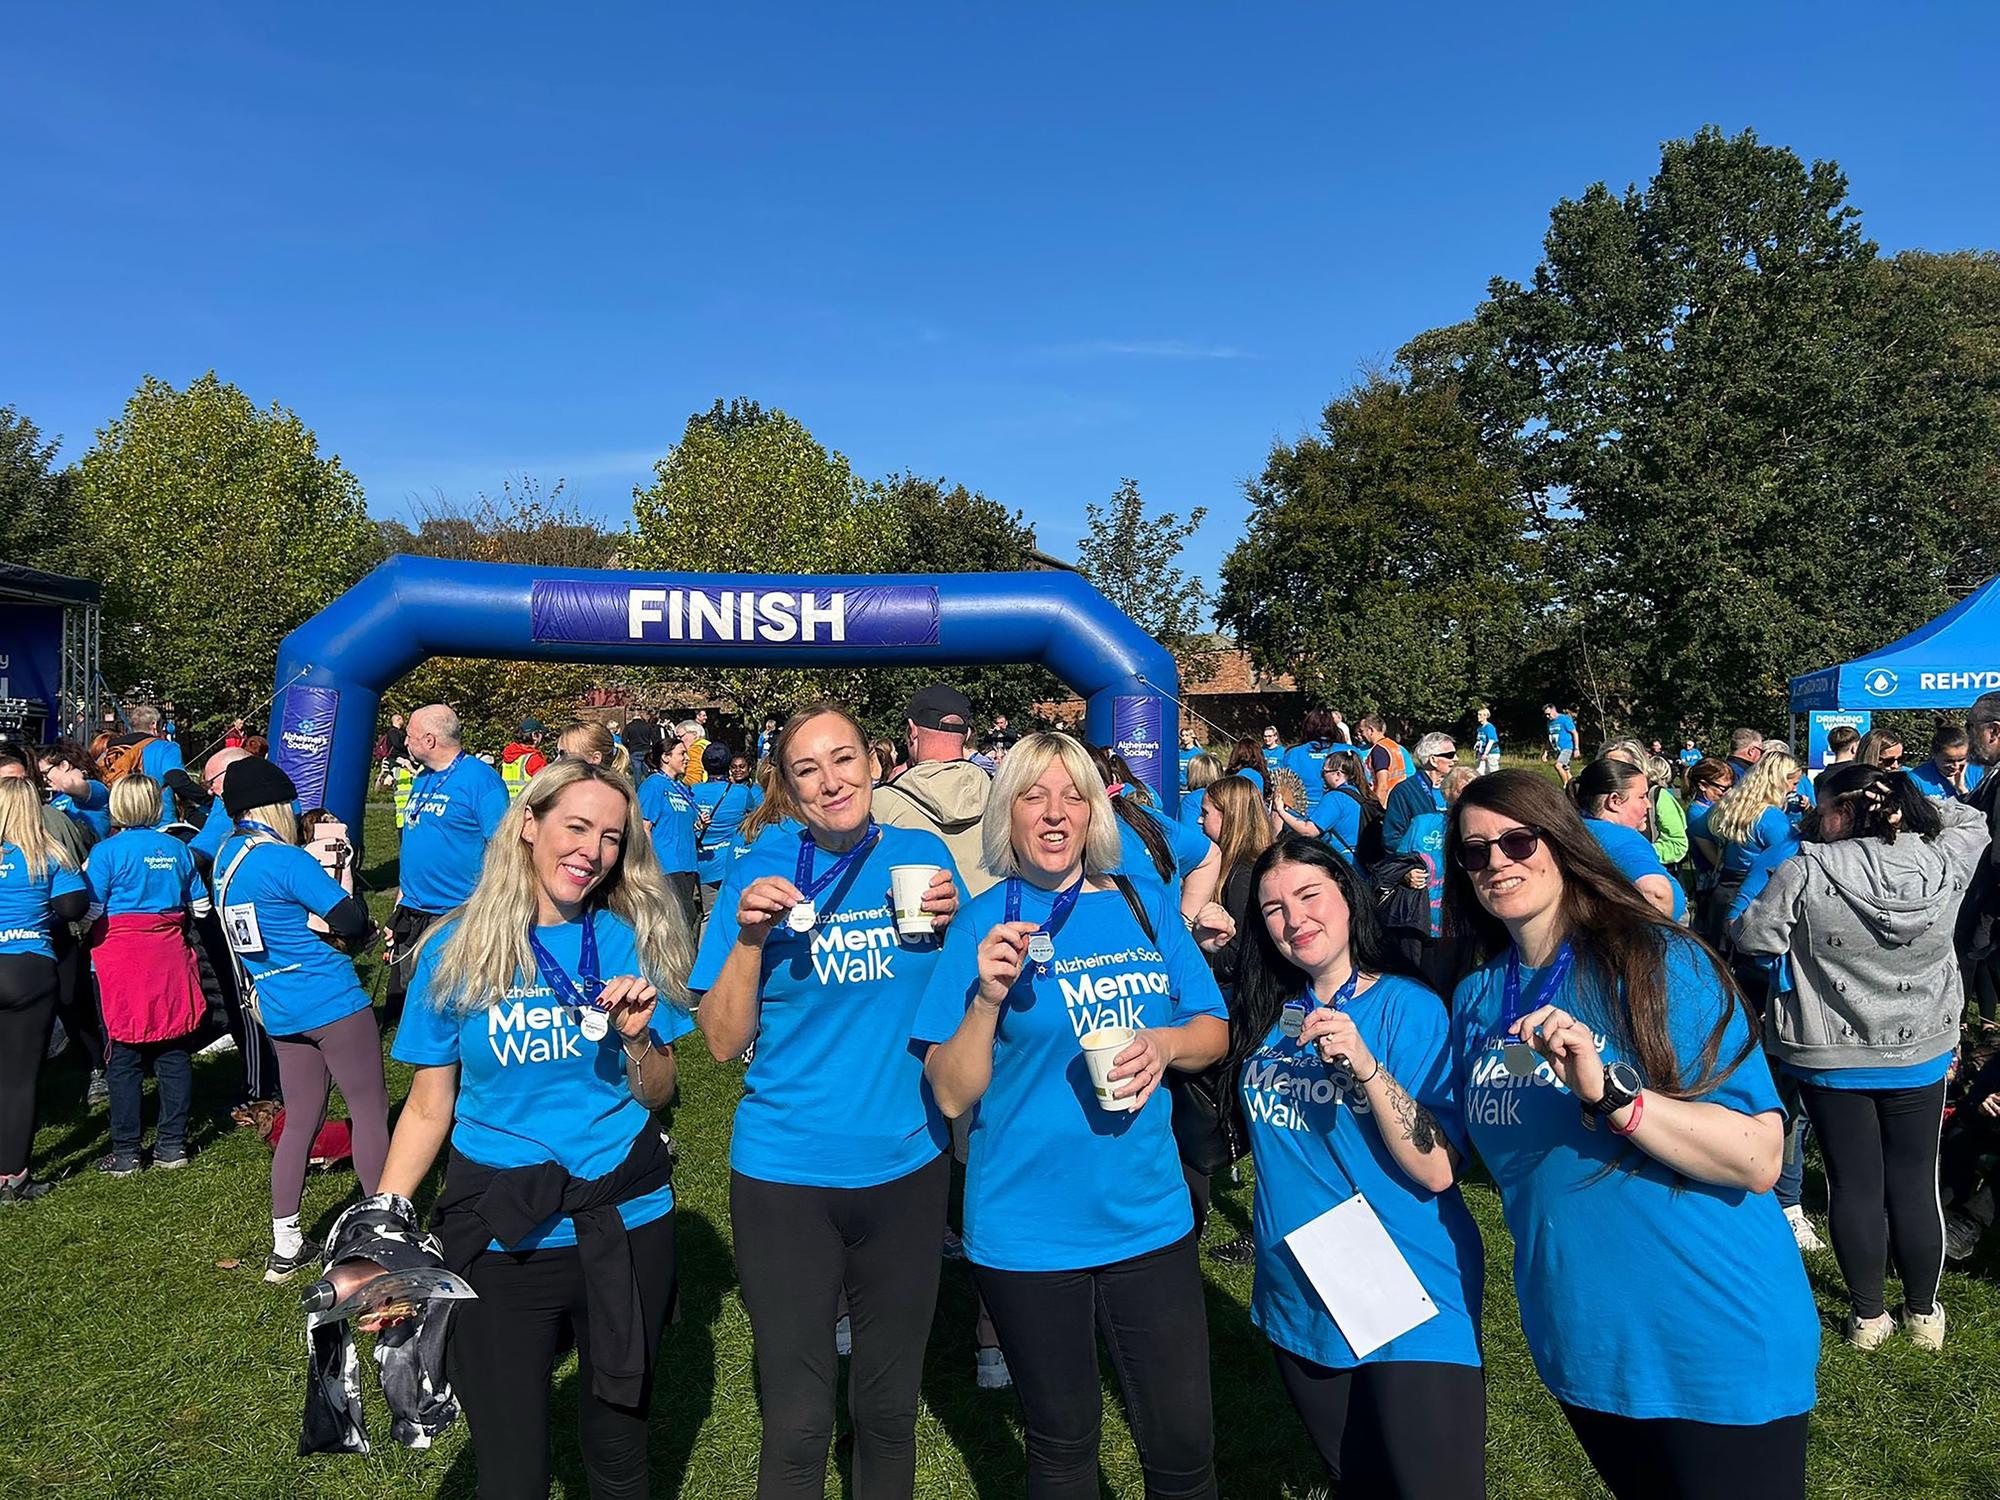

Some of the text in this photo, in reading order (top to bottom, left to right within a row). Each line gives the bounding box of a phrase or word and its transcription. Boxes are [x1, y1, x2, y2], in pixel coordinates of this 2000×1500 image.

[629, 589, 845, 642] FINISH
[1815, 714, 1864, 724] DRINKING
[1117, 740, 1160, 750] Alzheimer's
[1123, 748, 1153, 759] Society
[810, 948, 895, 985] Walk
[1054, 948, 1139, 976] Alzheimer's
[1067, 997, 1147, 1038] Walk
[488, 1027, 583, 1067] Walk
[1243, 1089, 1311, 1133] Walk
[1467, 1088, 1522, 1126] Walk
